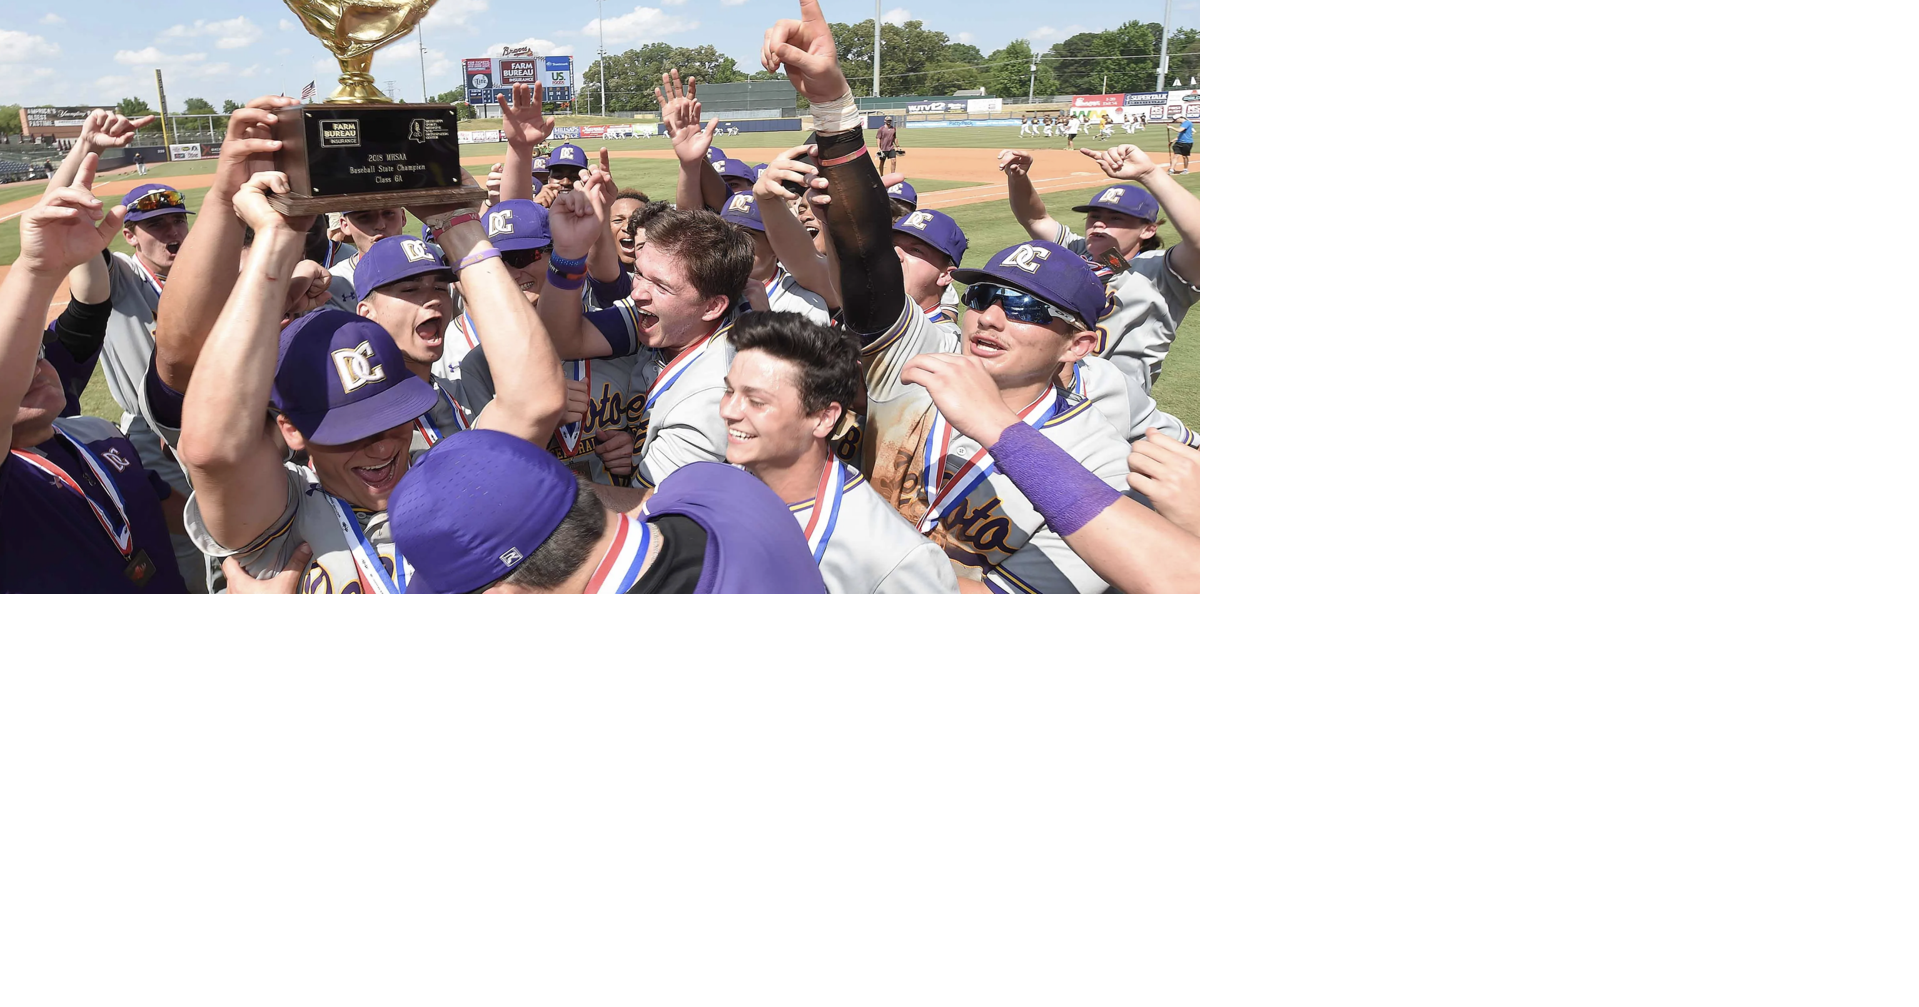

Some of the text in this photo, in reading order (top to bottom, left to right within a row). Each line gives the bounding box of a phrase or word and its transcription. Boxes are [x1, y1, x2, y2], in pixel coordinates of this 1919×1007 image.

[502, 46, 528, 56] Braves
[324, 130, 356, 138] BUREAU
[333, 123, 356, 131] FARM
[368, 154, 384, 162] 2018
[349, 166, 376, 175] Baseball
[397, 164, 426, 172] Champion
[375, 176, 392, 184] Class
[728, 193, 755, 214] DC
[1097, 187, 1126, 204] DC
[488, 209, 515, 238] DC
[902, 210, 935, 231] DC
[400, 239, 436, 264] DC
[999, 243, 1052, 275] DC
[330, 339, 387, 395] DC
